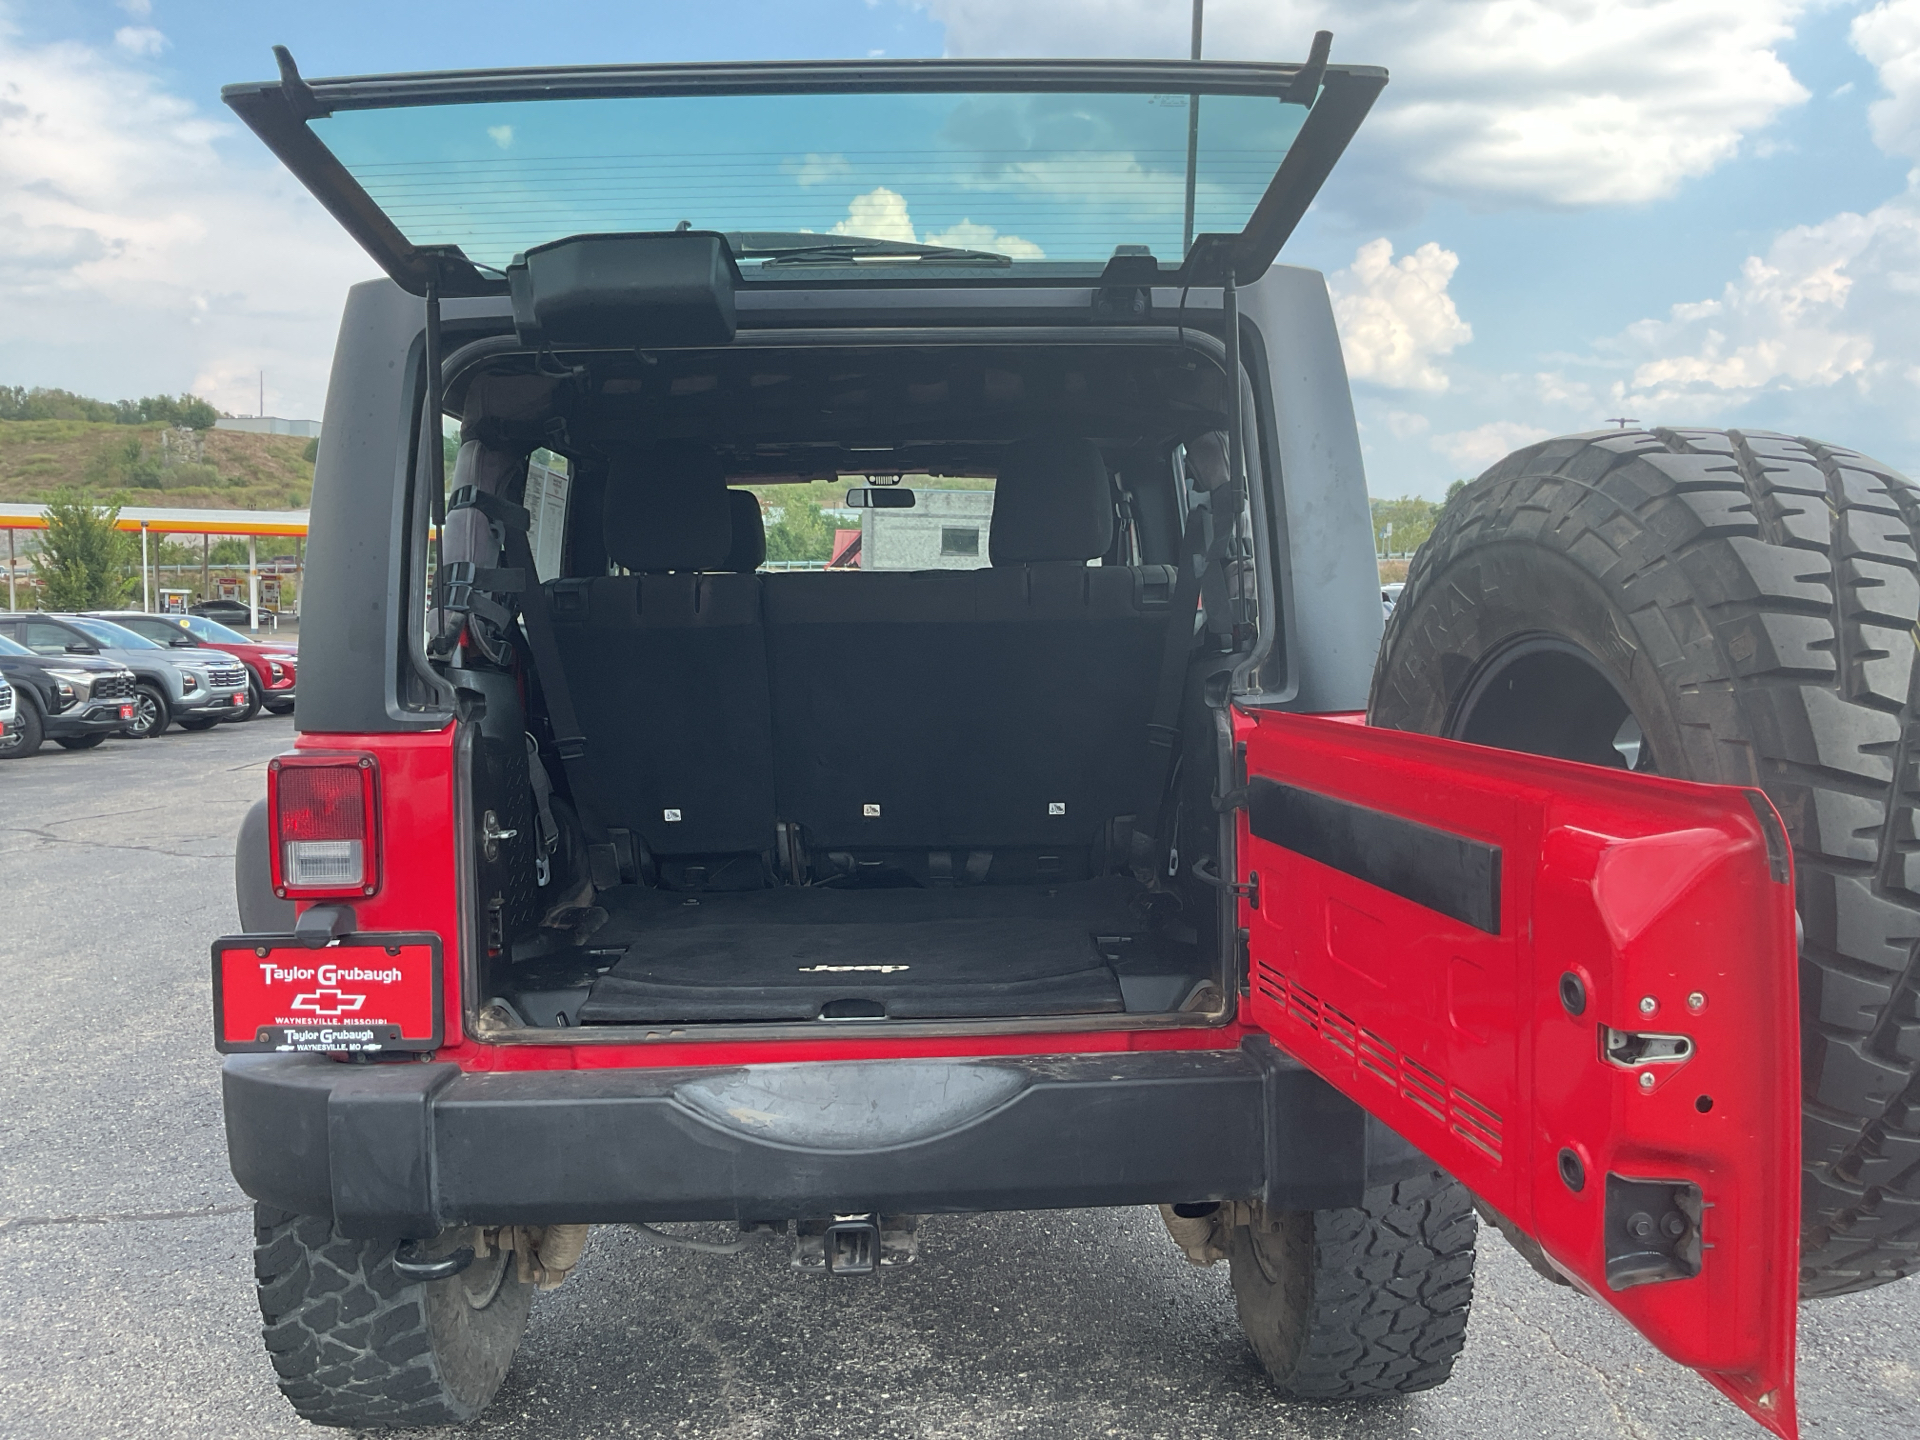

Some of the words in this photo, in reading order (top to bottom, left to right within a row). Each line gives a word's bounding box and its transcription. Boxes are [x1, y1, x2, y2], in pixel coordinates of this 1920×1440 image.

[799, 965, 910, 973] Jeep
[260, 964, 314, 985] Taylor
[317, 964, 402, 985] Grubaugh
[343, 1018, 388, 1026] MISSOURI
[283, 1029, 319, 1044] Taylor
[319, 1028, 374, 1043] Grubaugh
[349, 1043, 361, 1051] MO
